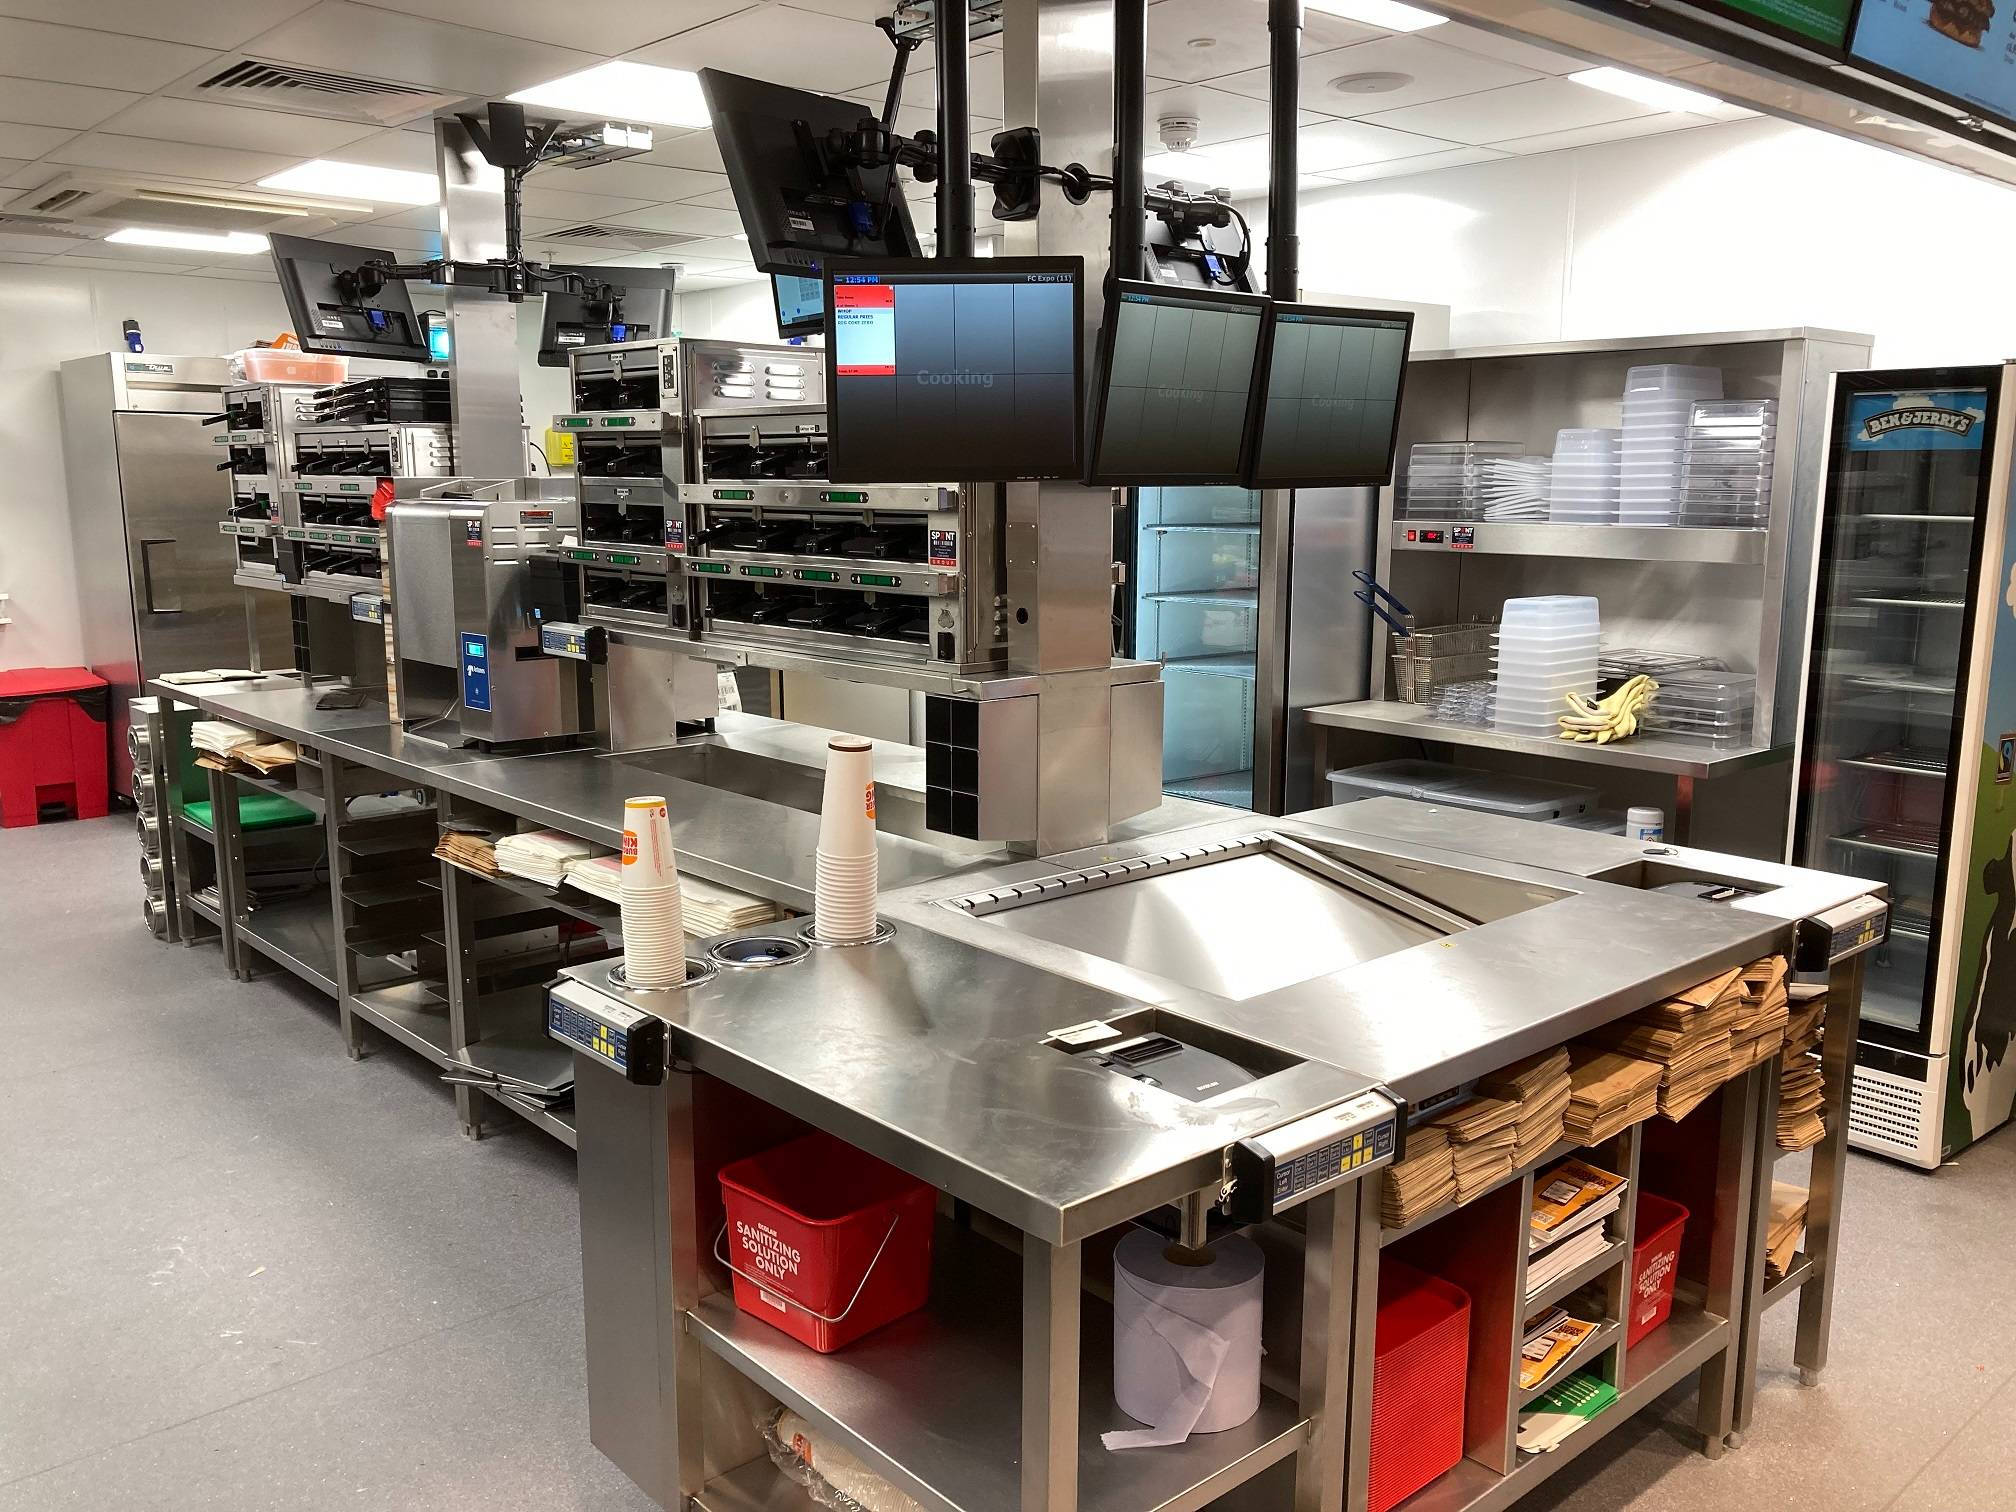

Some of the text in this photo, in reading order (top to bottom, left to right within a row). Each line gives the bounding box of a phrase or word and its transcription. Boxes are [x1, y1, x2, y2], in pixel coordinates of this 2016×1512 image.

[917, 370, 993, 388] Cooking
[737, 1221, 800, 1263] SANITIZING
[742, 1236, 798, 1276] SOLUTION
[755, 1256, 785, 1280] ONLY
[1639, 1250, 1675, 1285] SANITIZING
[1639, 1263, 1671, 1294] SOLUTION
[1644, 1278, 1662, 1298] ONLY
